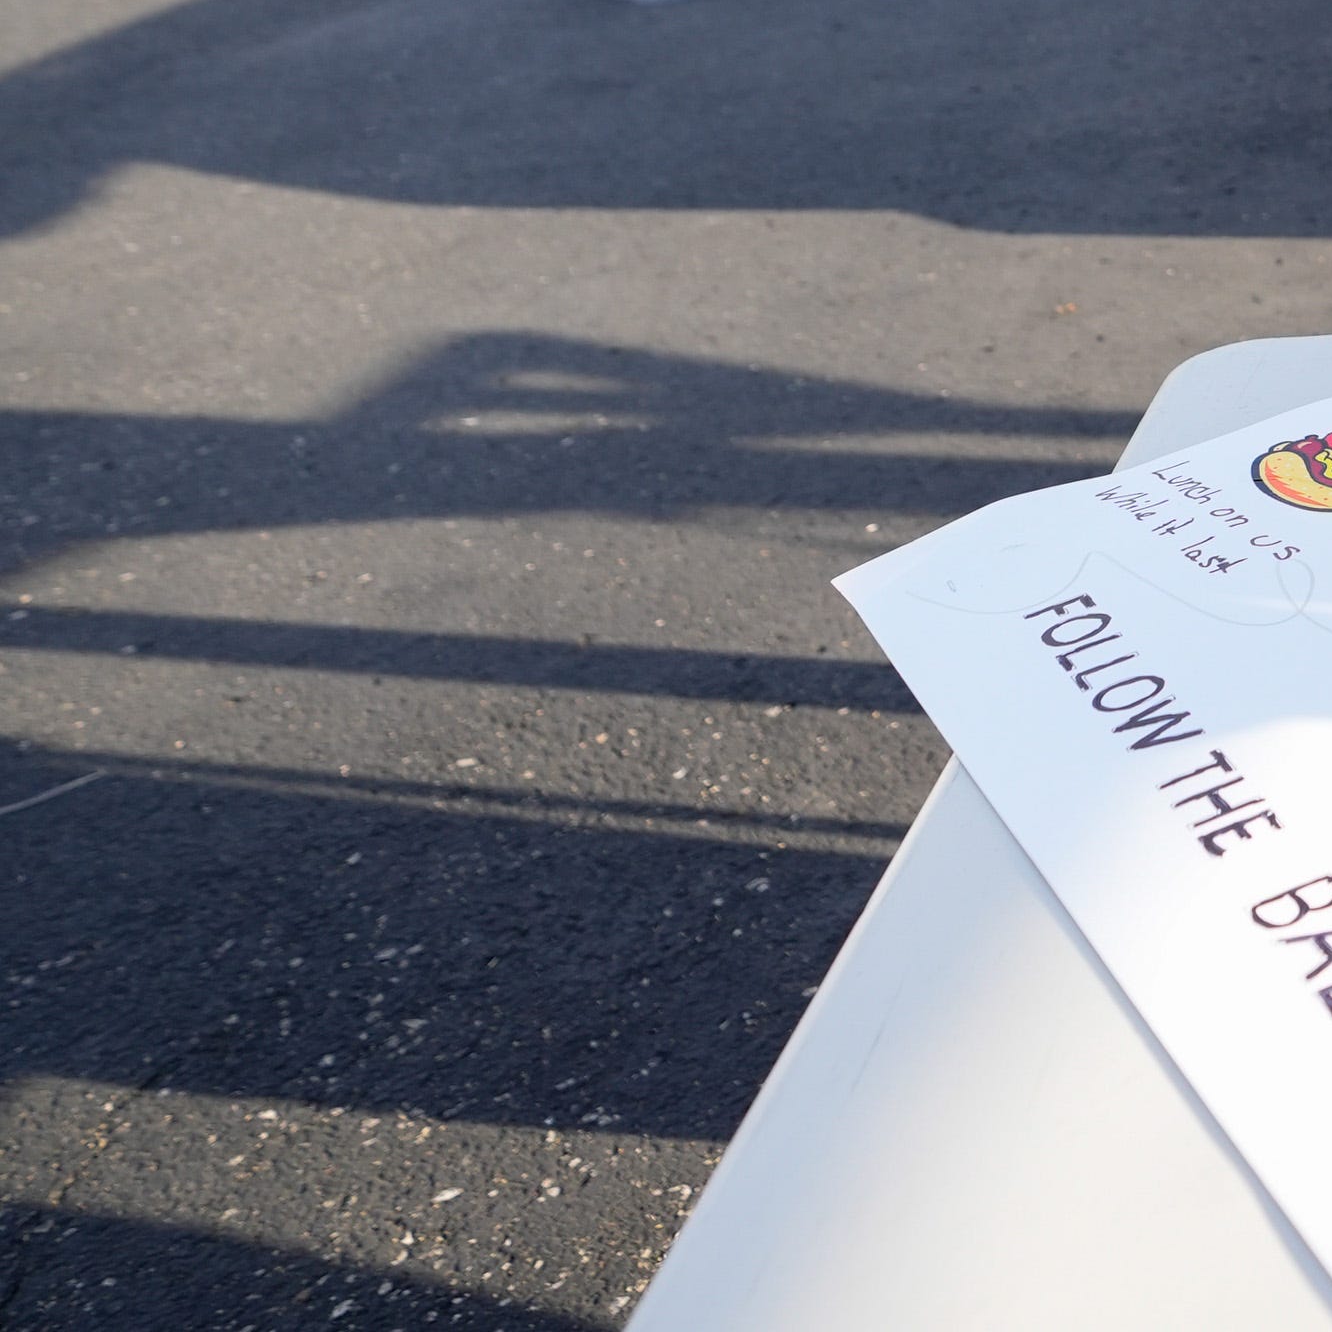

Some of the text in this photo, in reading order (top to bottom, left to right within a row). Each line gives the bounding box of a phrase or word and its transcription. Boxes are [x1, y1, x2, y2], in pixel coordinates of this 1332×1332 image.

[1151, 460, 1222, 506] Lunch
[1210, 506, 1249, 528] on
[1180, 535, 1248, 575] last
[1022, 593, 1205, 752] FOLLOW
[1158, 748, 1284, 858] THE
